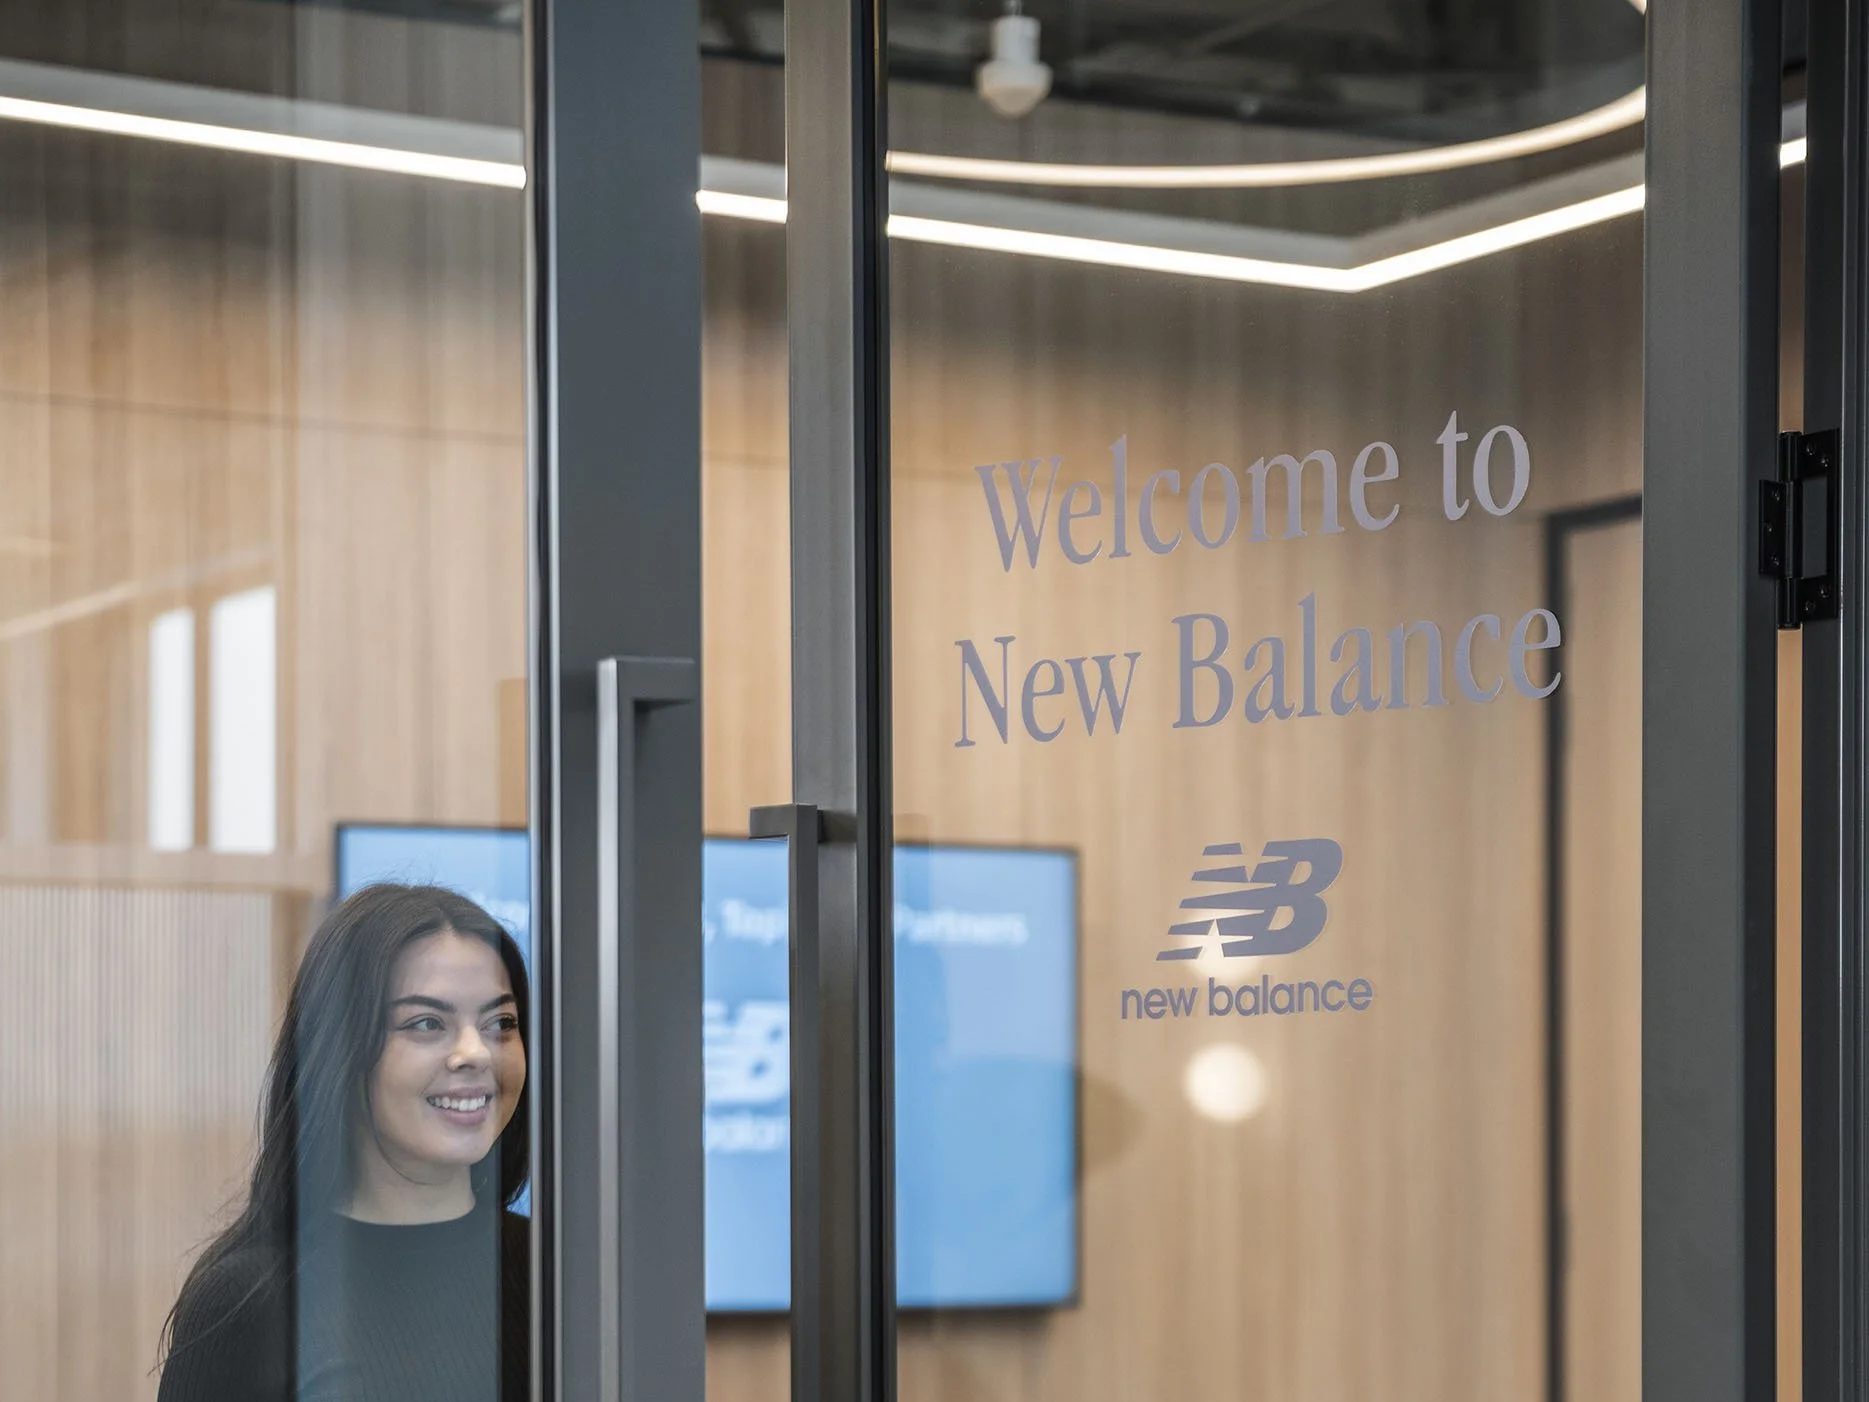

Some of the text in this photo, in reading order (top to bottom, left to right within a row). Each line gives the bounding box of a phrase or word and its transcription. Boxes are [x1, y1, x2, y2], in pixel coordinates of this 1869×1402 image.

[975, 410, 1530, 573] Welcome to
[954, 591, 1561, 747] New Balance
[1121, 975, 1373, 1020] new balance
